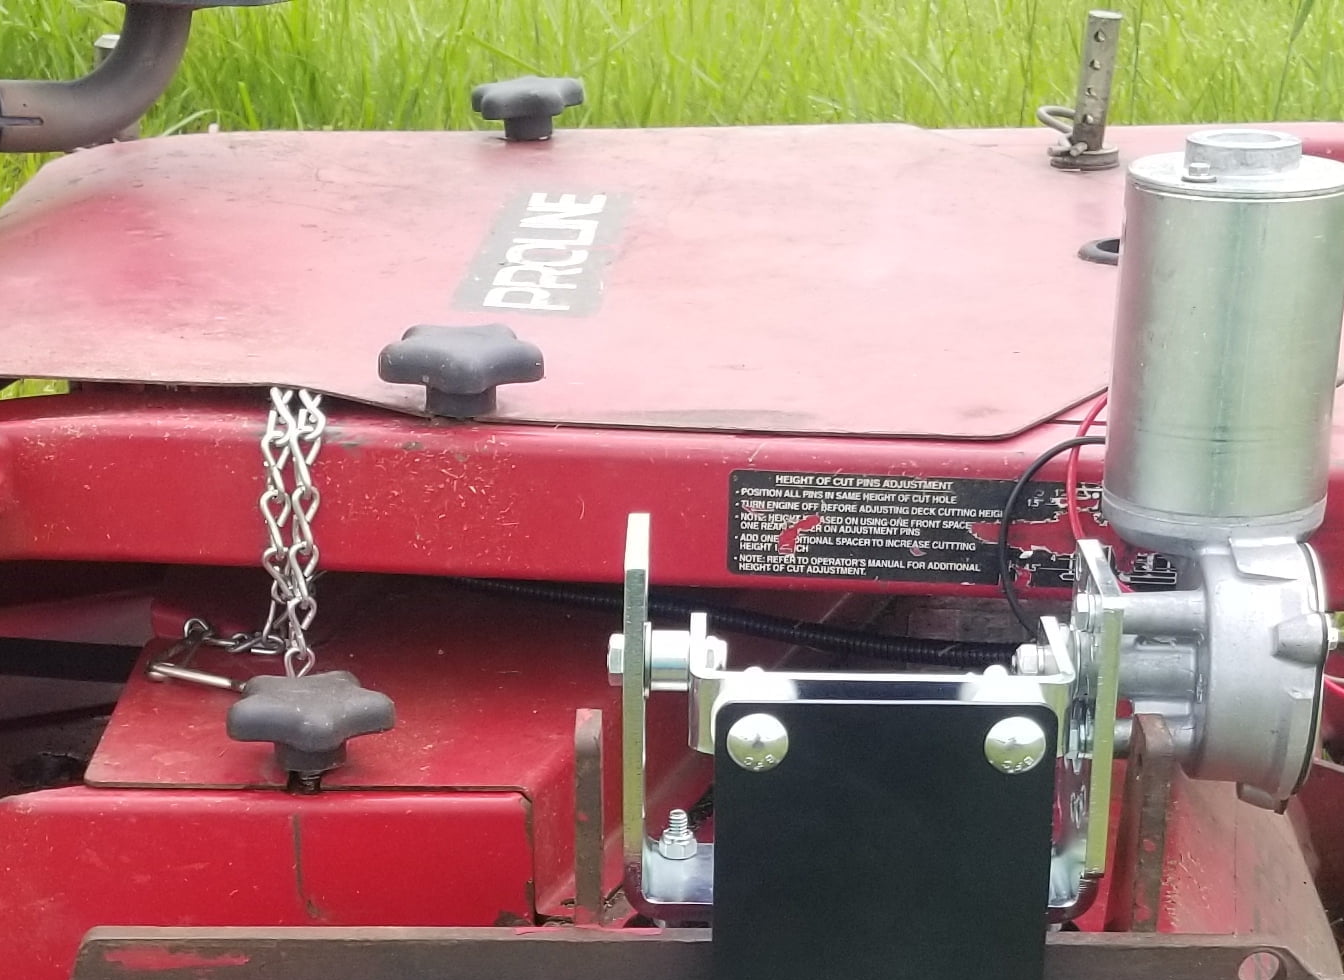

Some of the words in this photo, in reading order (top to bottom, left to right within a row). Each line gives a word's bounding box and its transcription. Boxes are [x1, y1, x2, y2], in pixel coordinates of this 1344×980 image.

[483, 192, 608, 311] PROLINE
[776, 475, 815, 485] HEIGHT
[816, 477, 831, 485] OF
[833, 478, 855, 486] CUT
[856, 479, 880, 487] PINS
[882, 480, 954, 490] ADJUSTMENT
[741, 488, 783, 497] POSITION
[783, 490, 801, 498] ALL
[802, 490, 824, 499] PINS
[825, 491, 835, 499] IN
[836, 492, 861, 500] SAME
[863, 493, 896, 502] HEIGHT
[898, 494, 911, 502] OF
[912, 495, 931, 503] CUT
[932, 496, 957, 504] HOLE
[741, 500, 765, 508] TURN
[766, 501, 800, 510] ENGINE
[802, 503, 819, 511] OFF
[821, 503, 858, 512] BEFORE
[859, 505, 909, 514] ADJUSTING
[911, 507, 936, 516] DECK
[938, 508, 976, 517] CUTTING
[740, 522, 760, 530] ONE
[824, 525, 837, 533] ON
[839, 526, 899, 536] ADJUSTMENT
[900, 527, 921, 536] PINS
[820, 516, 843, 525] ASED
[845, 517, 858, 525] ON
[860, 517, 889, 526] USING
[890, 518, 909, 527] ONE
[910, 520, 940, 529] FRONT
[942, 521, 971, 530] SPACE
[739, 542, 772, 551] HEIGHT
[740, 533, 759, 542] ADD
[760, 534, 779, 543] ONE
[836, 538, 871, 547] SPACER
[872, 539, 884, 547] TO
[885, 539, 930, 548] INCREASE
[739, 554, 765, 563] NOTE:
[767, 555, 795, 564] REFER
[797, 556, 810, 565] TO
[811, 557, 866, 567] OPERATOR'S
[868, 559, 905, 569] MANUAL
[907, 560, 926, 570] FOR
[927, 561, 981, 571] ADDITIONAL
[739, 562, 771, 571] HEIGHT
[772, 564, 785, 572] OF
[786, 564, 805, 573] CUT
[806, 565, 867, 576] ADJUSTMENT.
